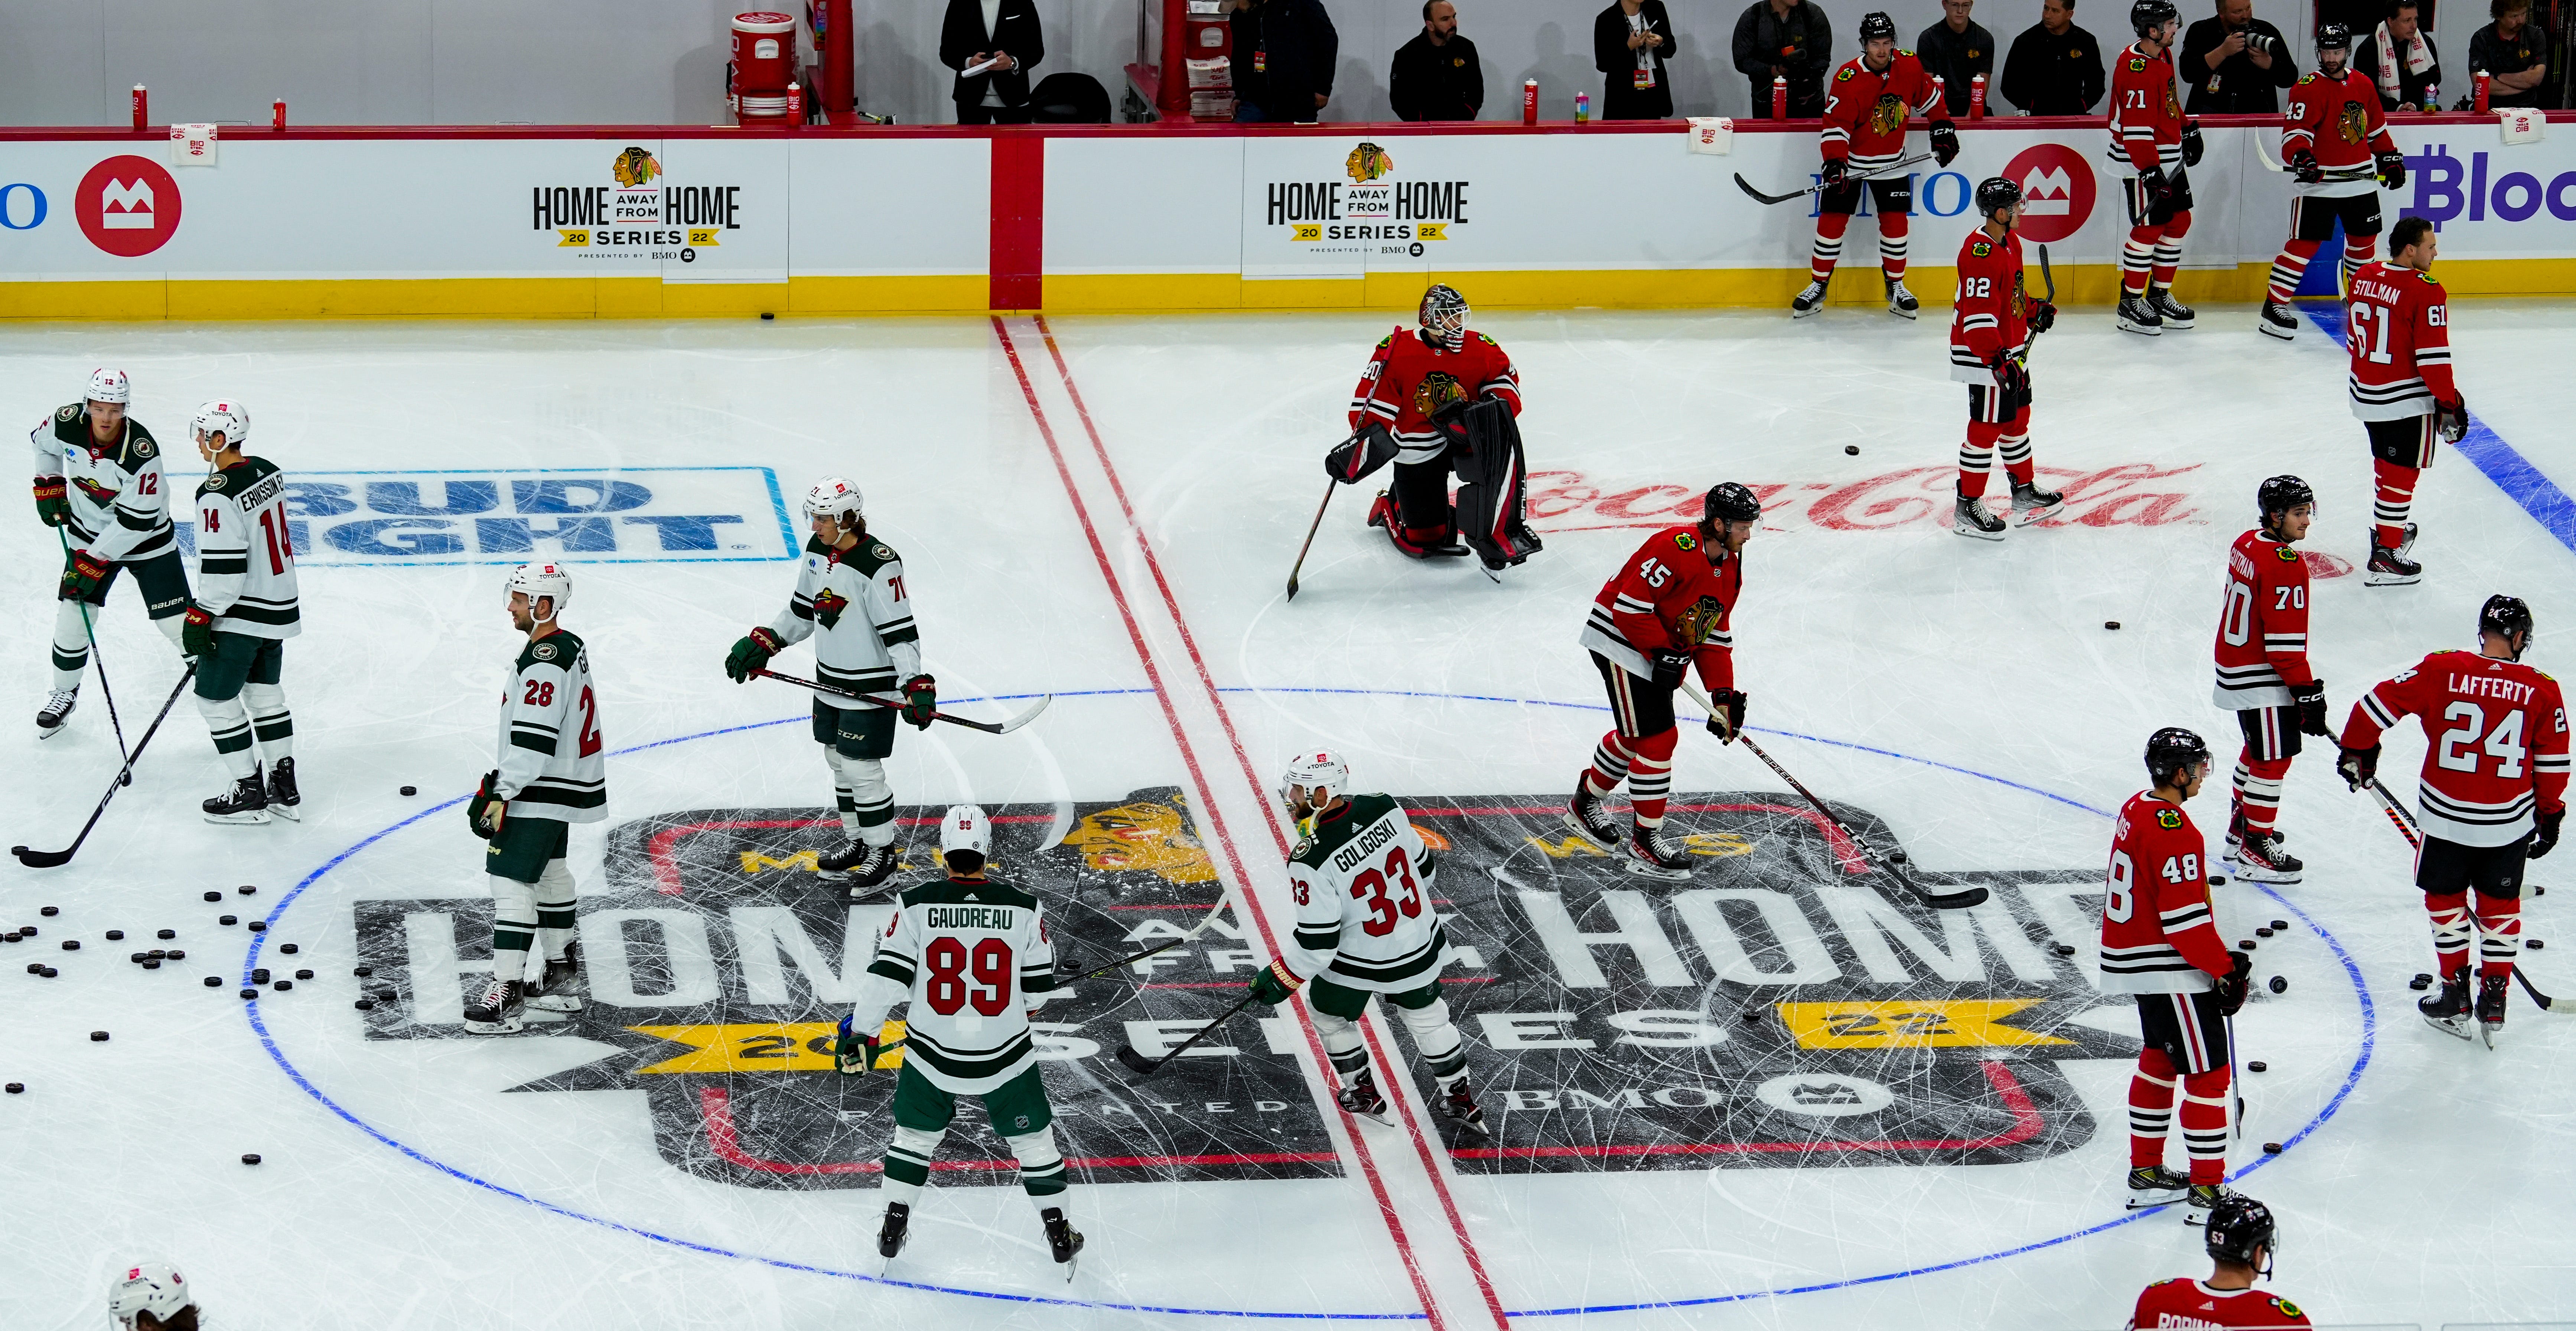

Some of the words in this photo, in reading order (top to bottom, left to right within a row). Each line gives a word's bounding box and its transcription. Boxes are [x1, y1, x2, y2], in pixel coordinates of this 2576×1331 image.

[2126, 90, 2146, 108] 71
[2285, 102, 2306, 120] 43
[2141, 171, 2156, 183] CM
[534, 187, 609, 230] HOME
[616, 195, 658, 204] AWAY
[665, 186, 740, 229] HOME
[616, 208, 658, 217] FROM
[1268, 182, 1342, 225] HOME
[1348, 190, 1389, 199] AWAY
[1396, 182, 1469, 223] HOME
[1348, 202, 1389, 212] FROM
[569, 234, 586, 242] 20
[596, 230, 682, 245] SERIES
[692, 233, 708, 242] 22
[1302, 228, 1318, 237] 20
[1328, 225, 1411, 240] SERIES
[1421, 227, 1436, 236] 22
[1966, 277, 1991, 298] 82
[2353, 279, 2401, 305] STILLMAN
[2428, 305, 2447, 326] 61
[2350, 301, 2393, 365] 61
[1333, 438, 1358, 453] TRUE
[138, 472, 157, 495] 12
[240, 475, 278, 513] ERIKSSON
[834, 489, 853, 500] TOYOTA
[203, 508, 220, 533] 14
[1384, 508, 1398, 539] TRUE
[260, 501, 294, 576] 14
[1640, 557, 1672, 588] 45
[2375, 561, 2389, 572] CCM
[888, 575, 907, 602] 71
[2275, 586, 2305, 610] 70
[151, 596, 184, 610] BAUER
[2488, 608, 2499, 618] 24
[753, 631, 780, 655] TRU
[1662, 655, 1690, 664] CC
[524, 679, 555, 707] 28
[2448, 672, 2535, 705] LAFFERTY
[838, 728, 866, 741] CCM
[2438, 701, 2525, 778] 24
[1746, 741, 1795, 785] JETSPEED
[488, 845, 501, 855] CM
[1334, 818, 1398, 874] GOLIGOSKI
[1632, 841, 1658, 865] CCM
[1838, 822, 1886, 865] CCM
[2162, 853, 2198, 883] 48
[2241, 847, 2270, 869] CCM
[1290, 876, 1309, 906] 33
[1349, 845, 1421, 937] 33
[928, 907, 1013, 930] GAUDREAU
[925, 936, 1013, 1017] 89
[1821, 1013, 1956, 1036] 22
[1504, 1088, 1723, 1112] BMO
[2212, 1231, 2224, 1245] 53
